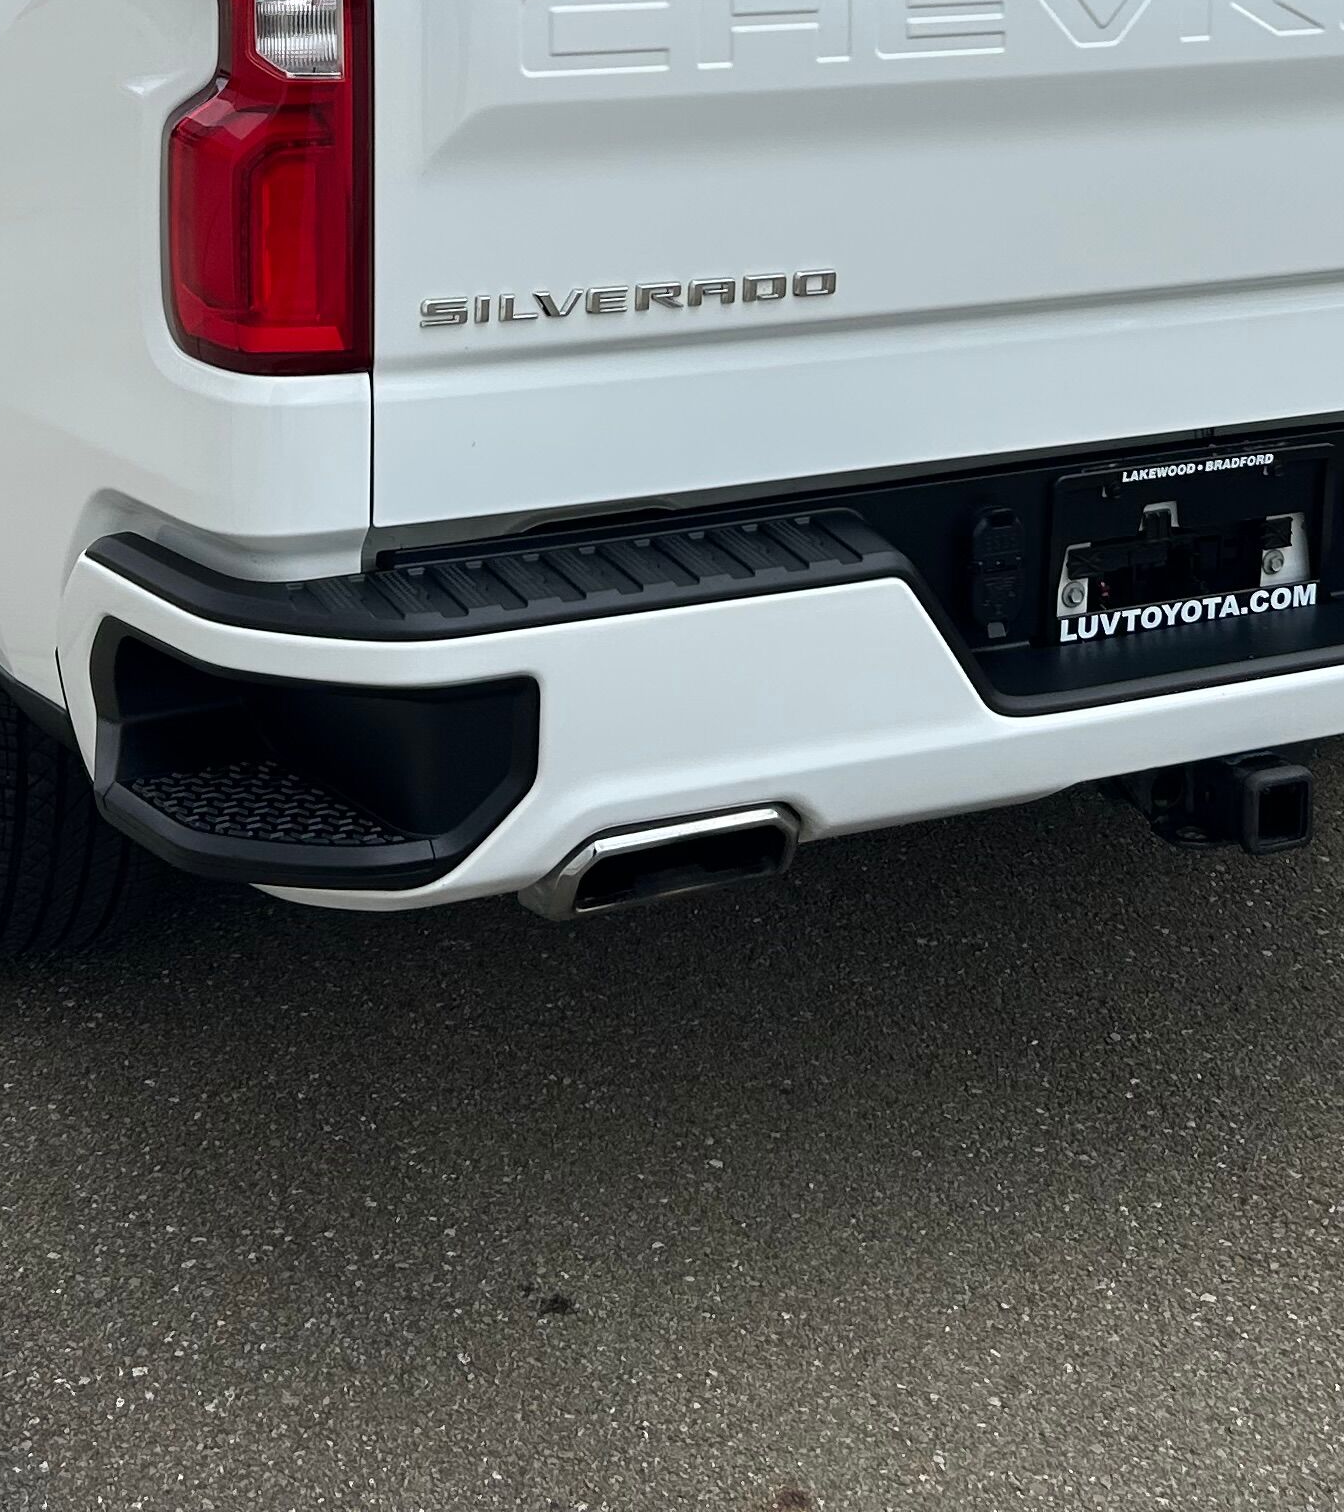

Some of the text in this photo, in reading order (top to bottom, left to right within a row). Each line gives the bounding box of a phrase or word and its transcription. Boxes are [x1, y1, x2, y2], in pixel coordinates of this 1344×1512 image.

[419, 267, 838, 328] SILVERADO
[1122, 453, 1274, 483] LAKEWOOD BRADFORD
[1059, 583, 1317, 642] LUVTOYOTA.COM
